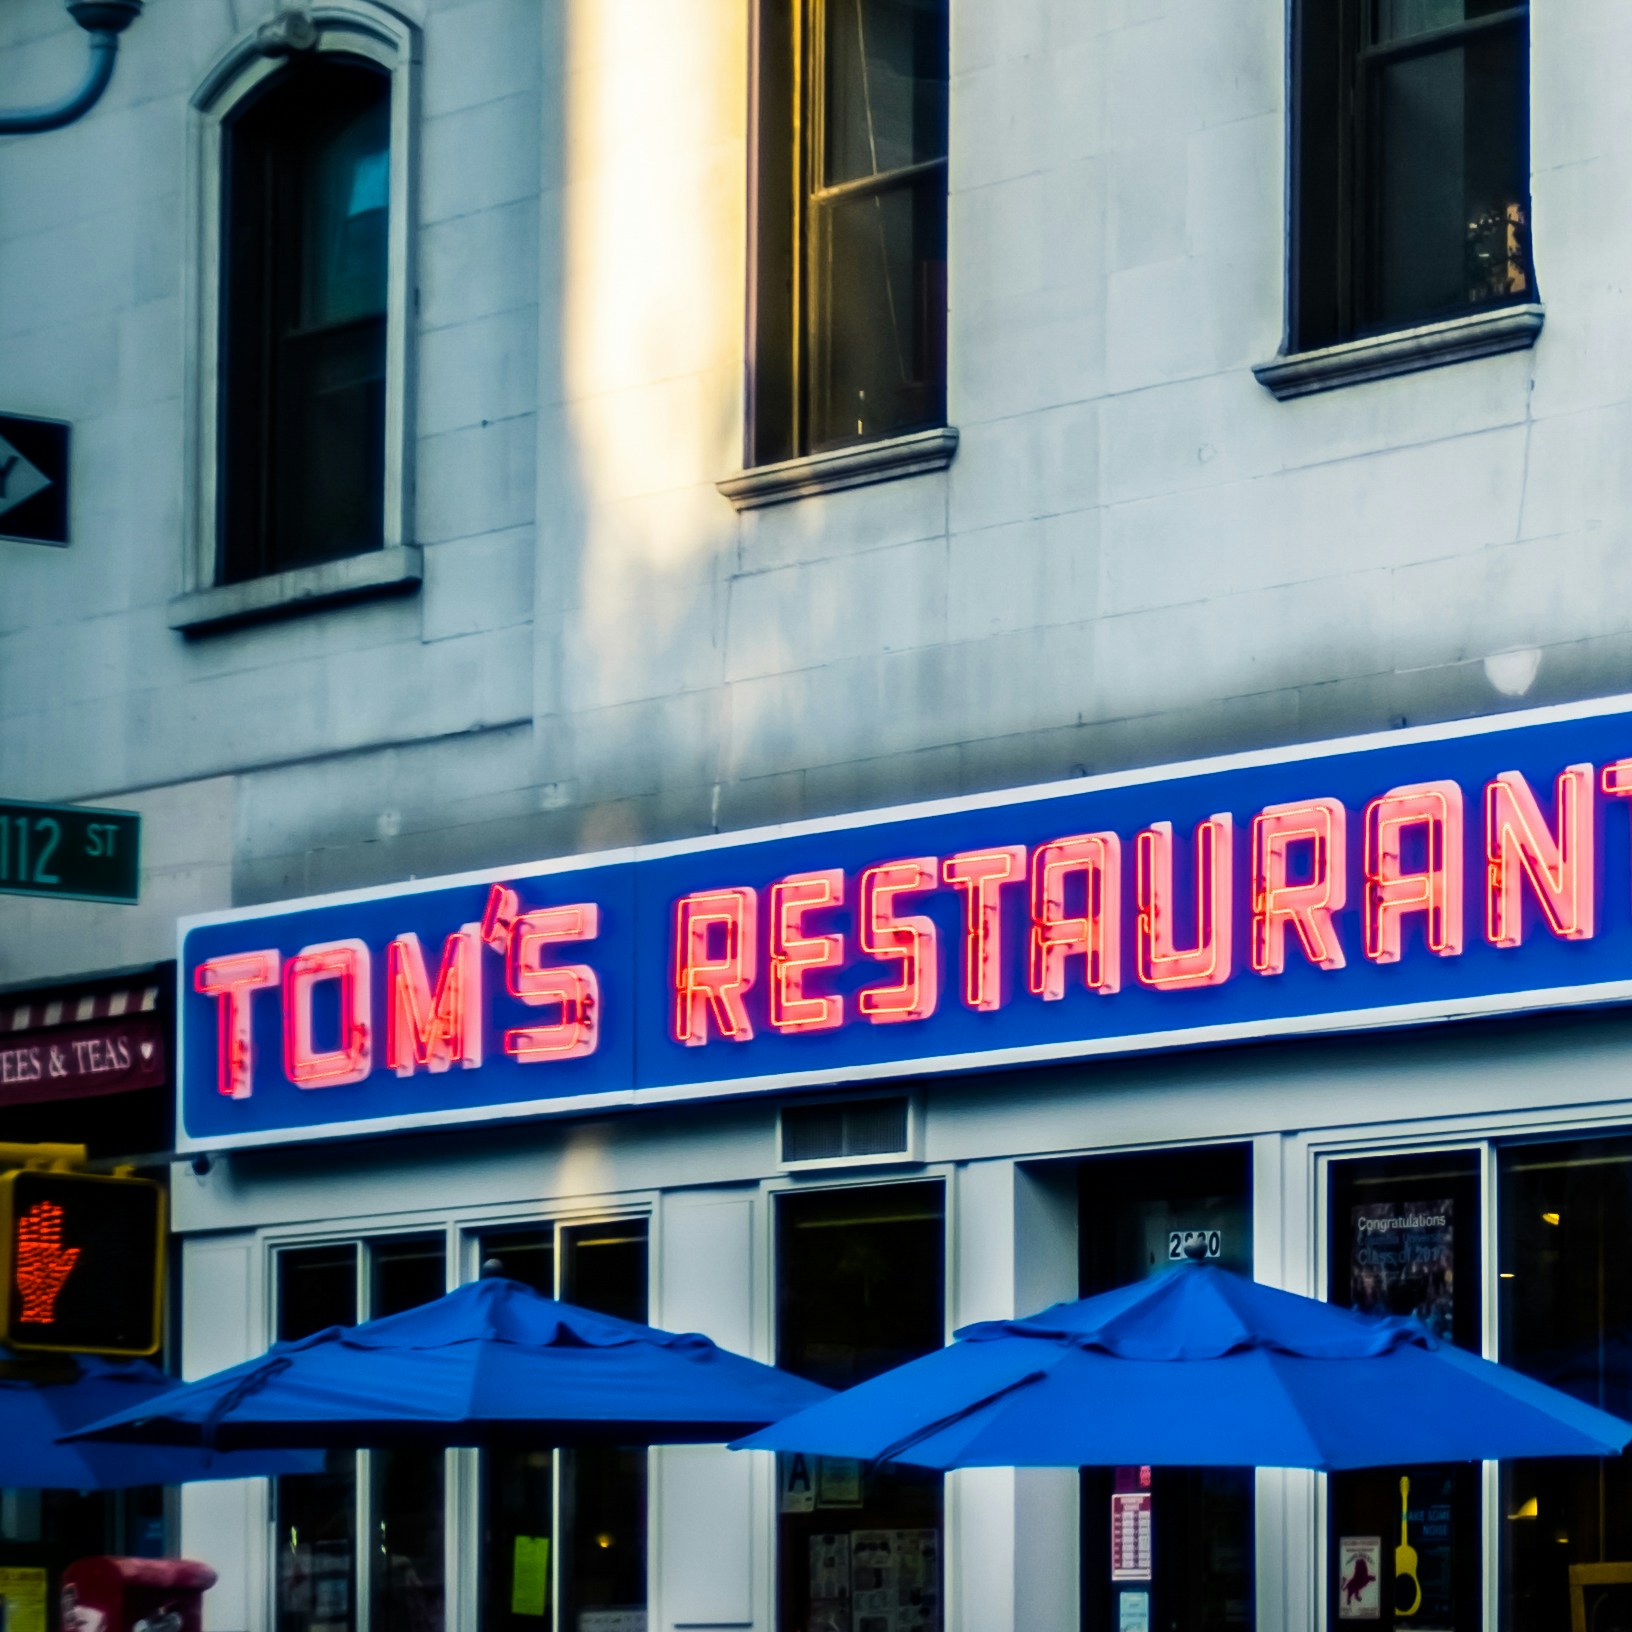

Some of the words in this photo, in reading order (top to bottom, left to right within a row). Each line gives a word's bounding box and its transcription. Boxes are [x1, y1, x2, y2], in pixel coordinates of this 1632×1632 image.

[86, 823, 118, 857] ST
[195, 883, 599, 1098] TOM'S
[49, 1044, 68, 1078] &
[72, 1035, 131, 1074] TEAS
[1358, 1214, 1446, 1232] Congratulations
[788, 1453, 810, 1492] A
